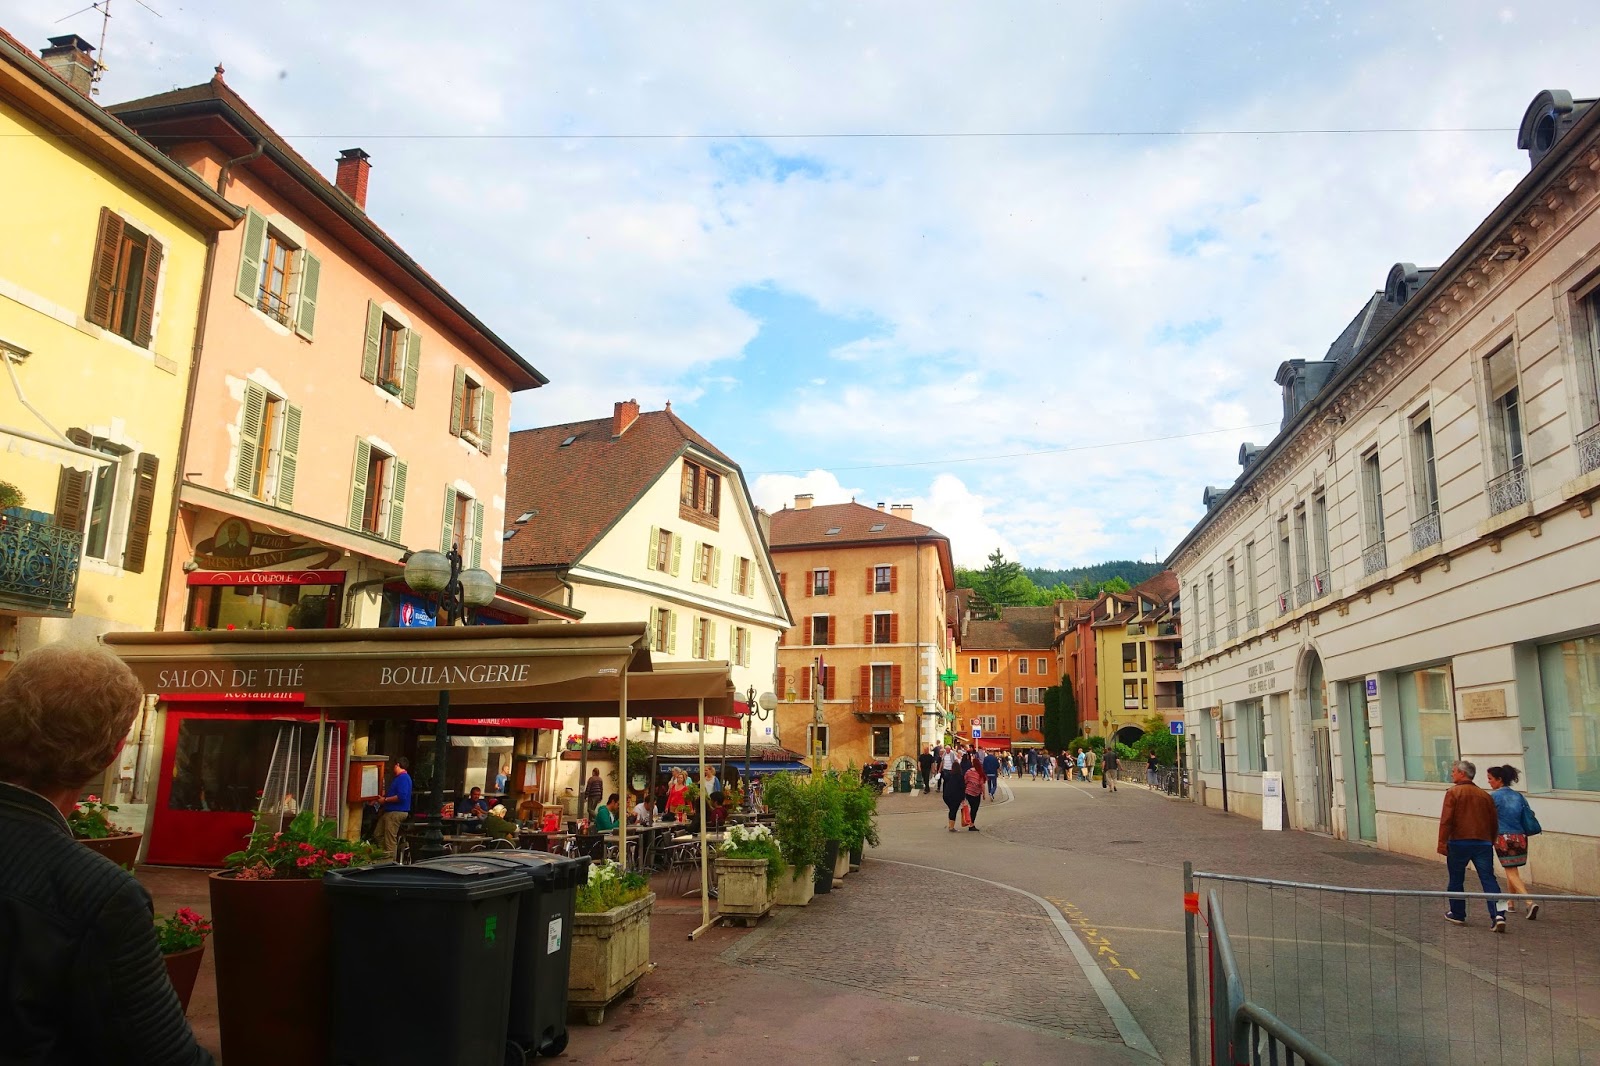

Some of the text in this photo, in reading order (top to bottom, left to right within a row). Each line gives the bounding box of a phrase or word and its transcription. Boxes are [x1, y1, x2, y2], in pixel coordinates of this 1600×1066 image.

[207, 551, 286, 568] RESTAURANT
[238, 573, 293, 583] LA COUPOLE
[157, 664, 304, 688] SALON DE THÉ
[380, 664, 530, 685] BOULANGERIE
